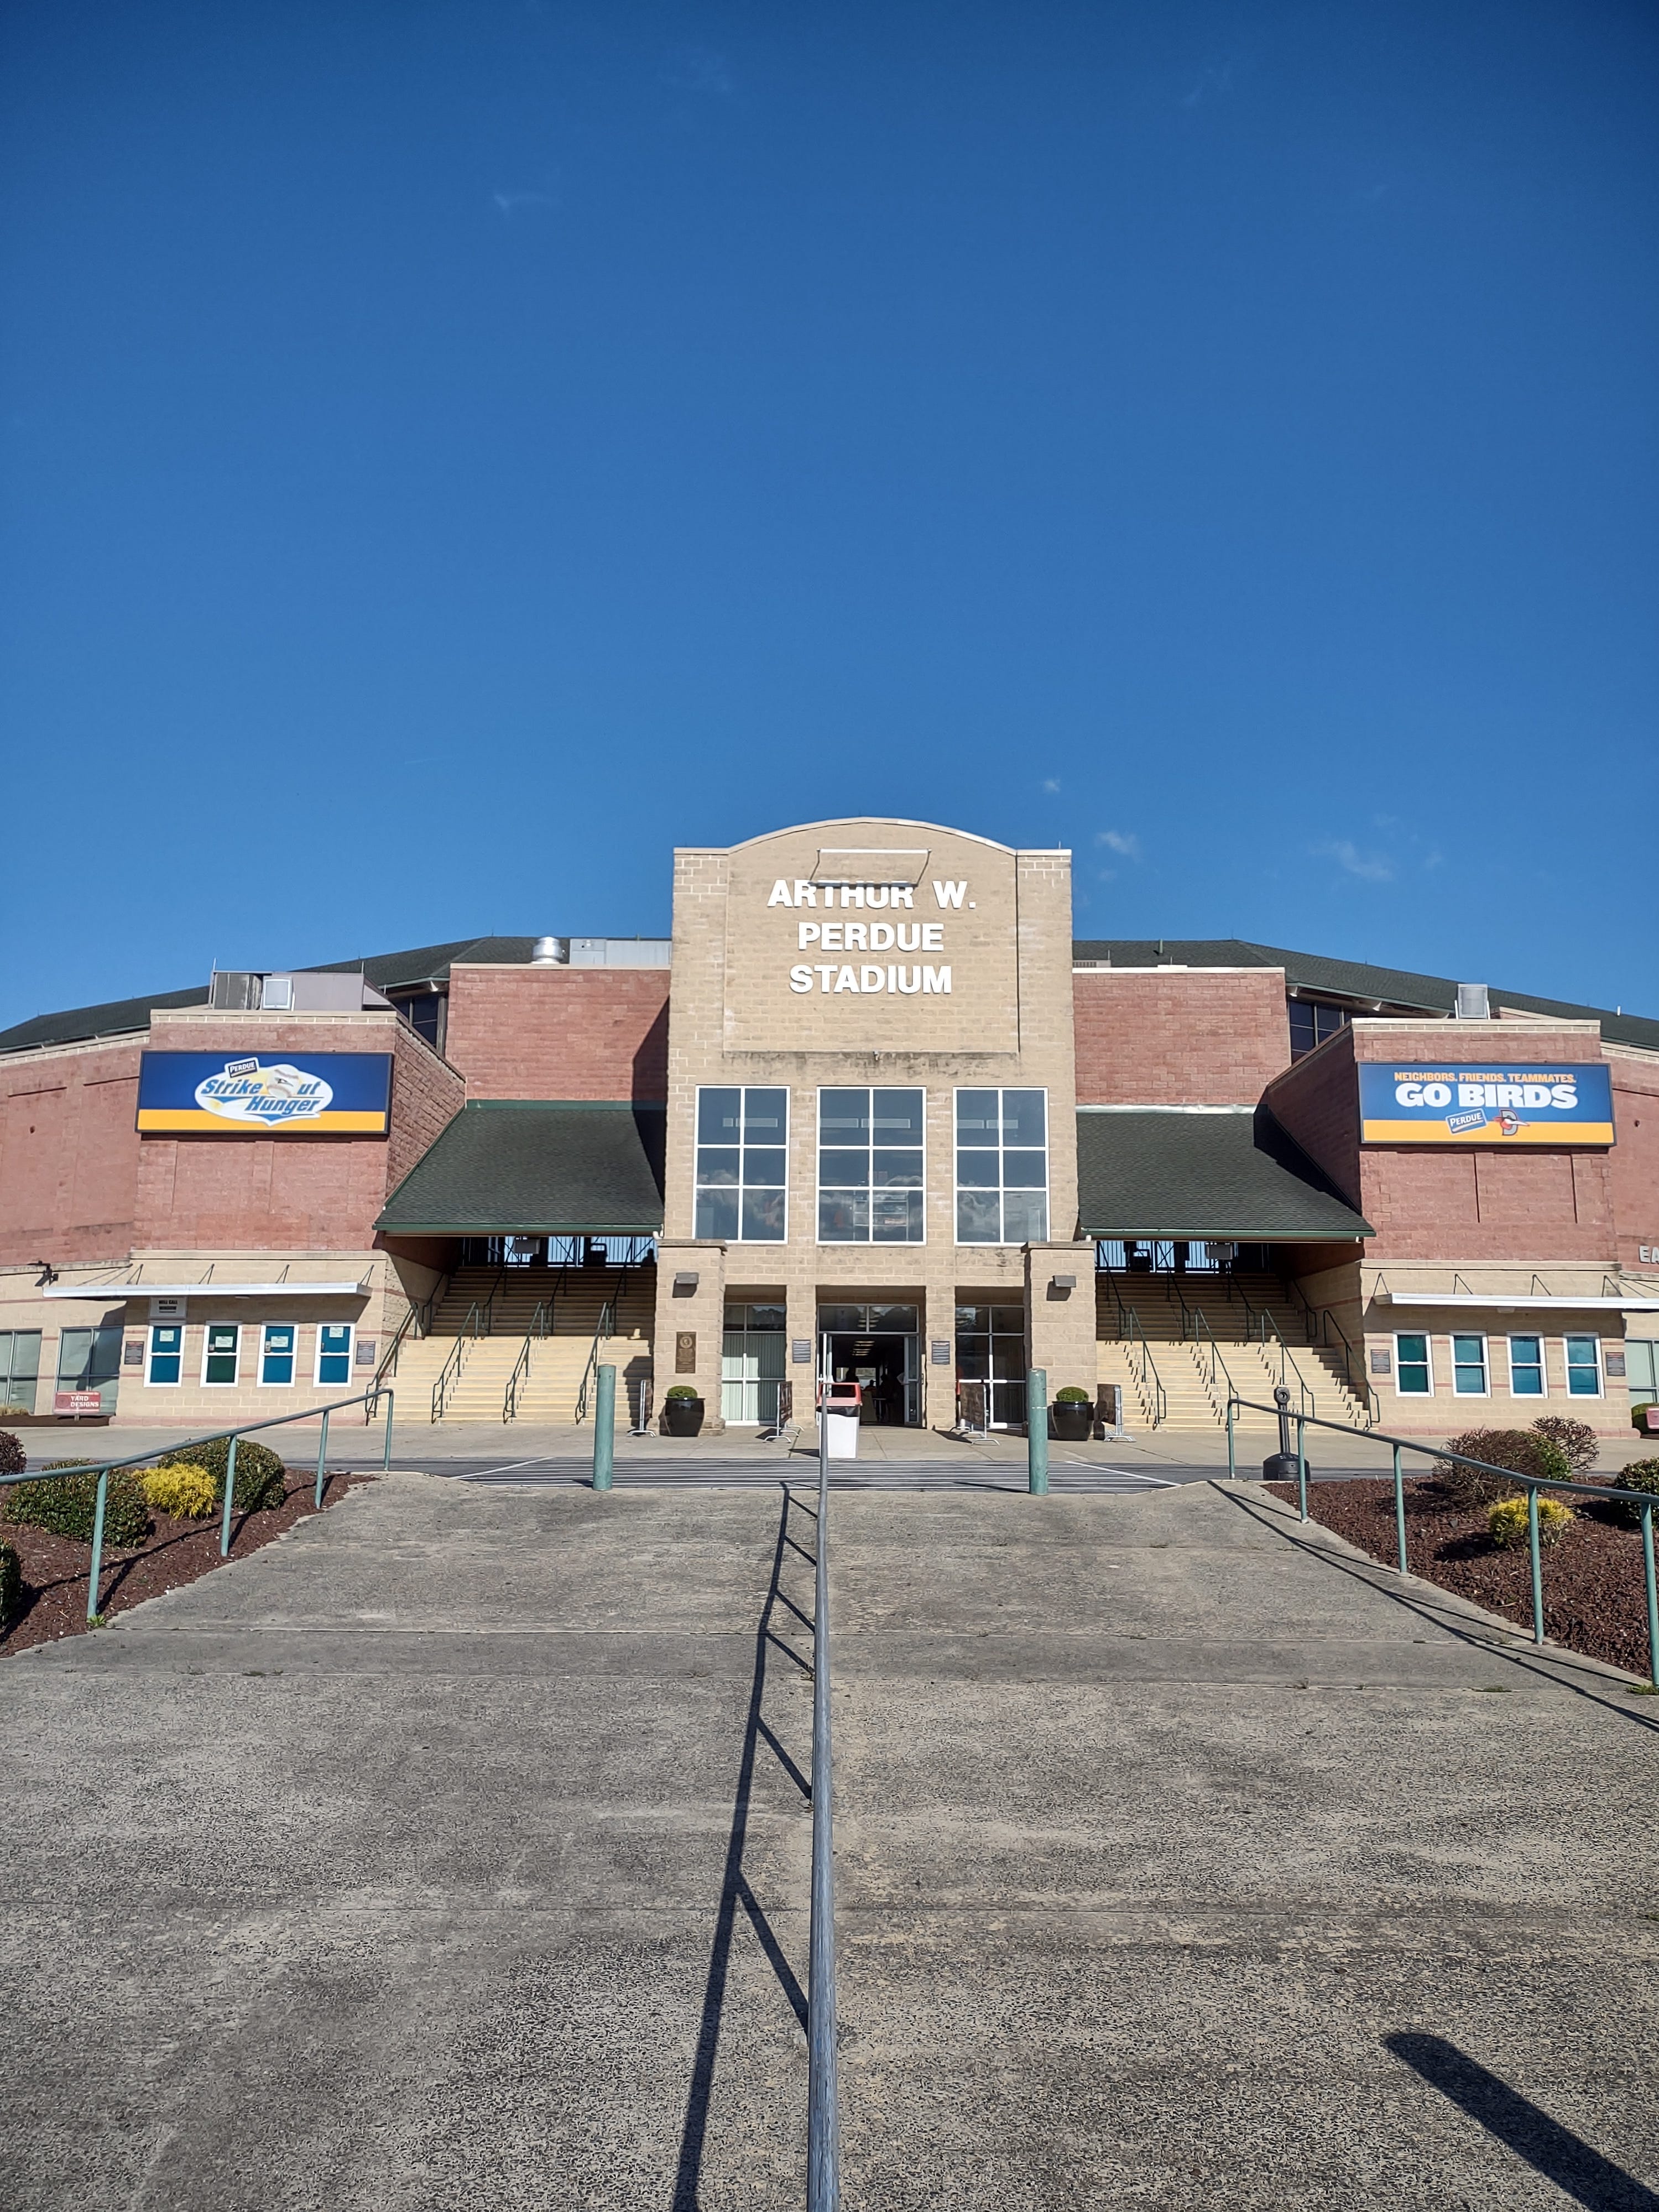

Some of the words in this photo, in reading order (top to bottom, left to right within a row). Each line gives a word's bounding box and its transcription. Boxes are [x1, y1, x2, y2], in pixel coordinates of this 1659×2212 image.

[767, 879, 914, 909] ARTHUR
[932, 880, 976, 909] W.
[798, 922, 944, 952] PERDUE
[789, 964, 952, 994] STADIUM
[229, 1061, 255, 1073] PERDUE
[201, 1079, 263, 1094] Strike
[1394, 1072, 1457, 1082] NEIGHBORS.
[1459, 1073, 1506, 1082] FRIENDS.
[1508, 1073, 1576, 1083] TEAMMATES.
[1395, 1082, 1452, 1107] GO
[1458, 1083, 1578, 1109] BIRDS
[244, 1096, 321, 1115] Hunger
[1449, 1112, 1481, 1126] PERDUE
